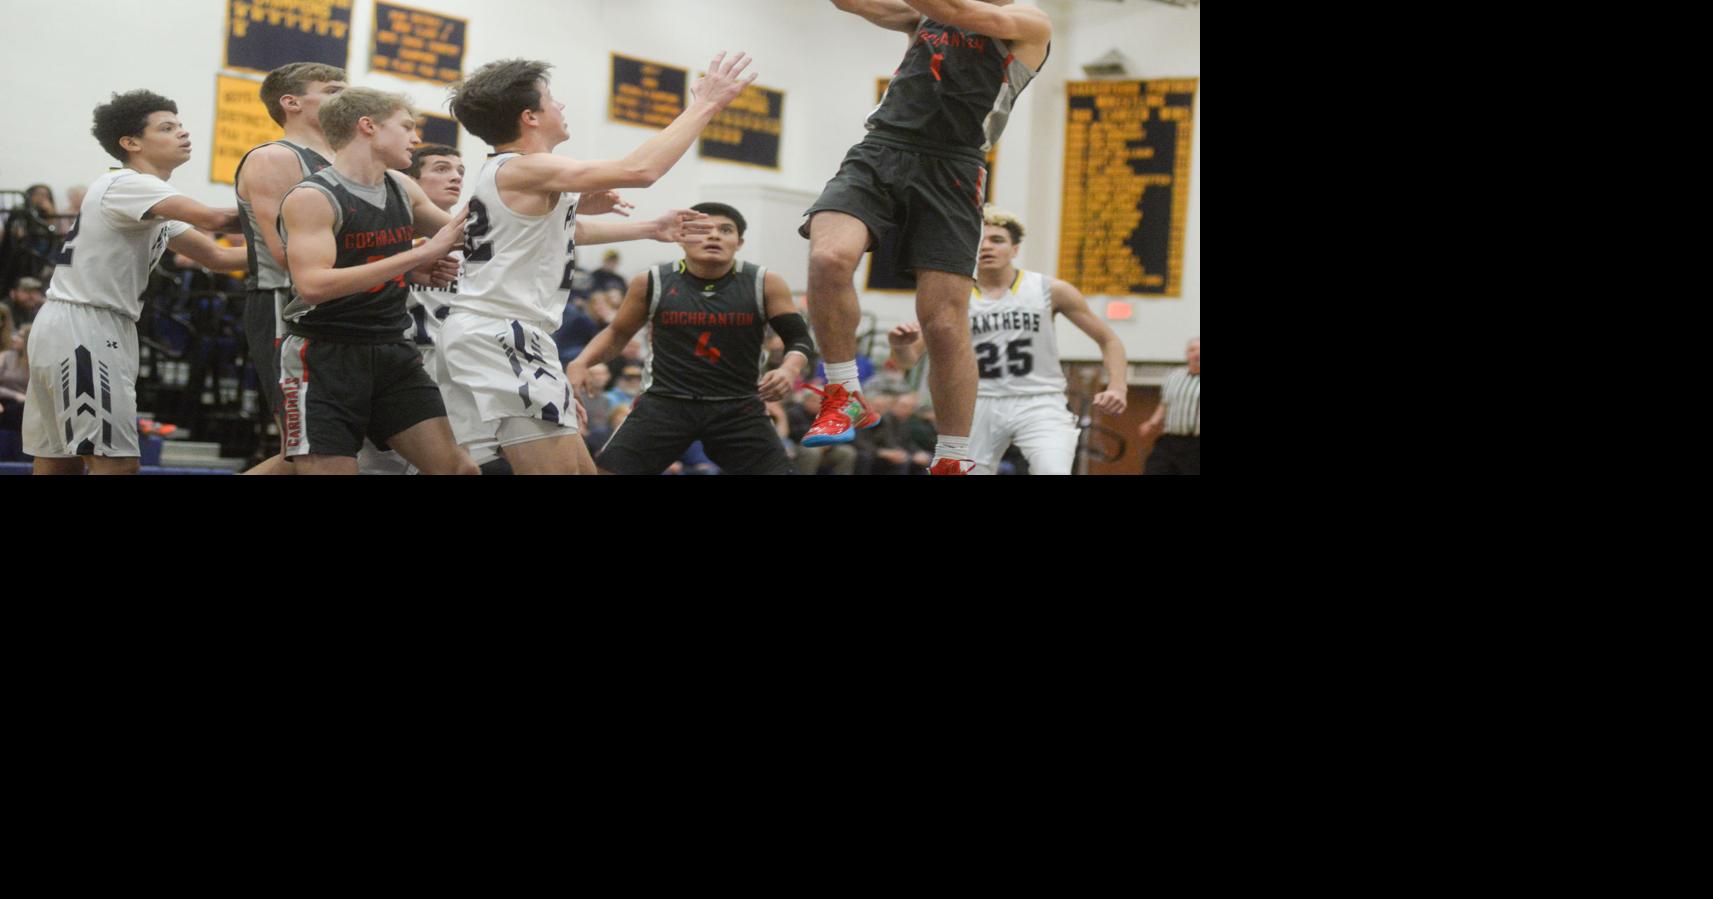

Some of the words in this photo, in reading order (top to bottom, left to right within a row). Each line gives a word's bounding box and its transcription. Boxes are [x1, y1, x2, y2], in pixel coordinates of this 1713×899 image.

[661, 311, 753, 327] COCHRANTON
[971, 311, 1040, 335] ANTHERS
[694, 331, 721, 365] 4
[974, 337, 1034, 379] 25
[283, 377, 301, 447] CARDINALS
